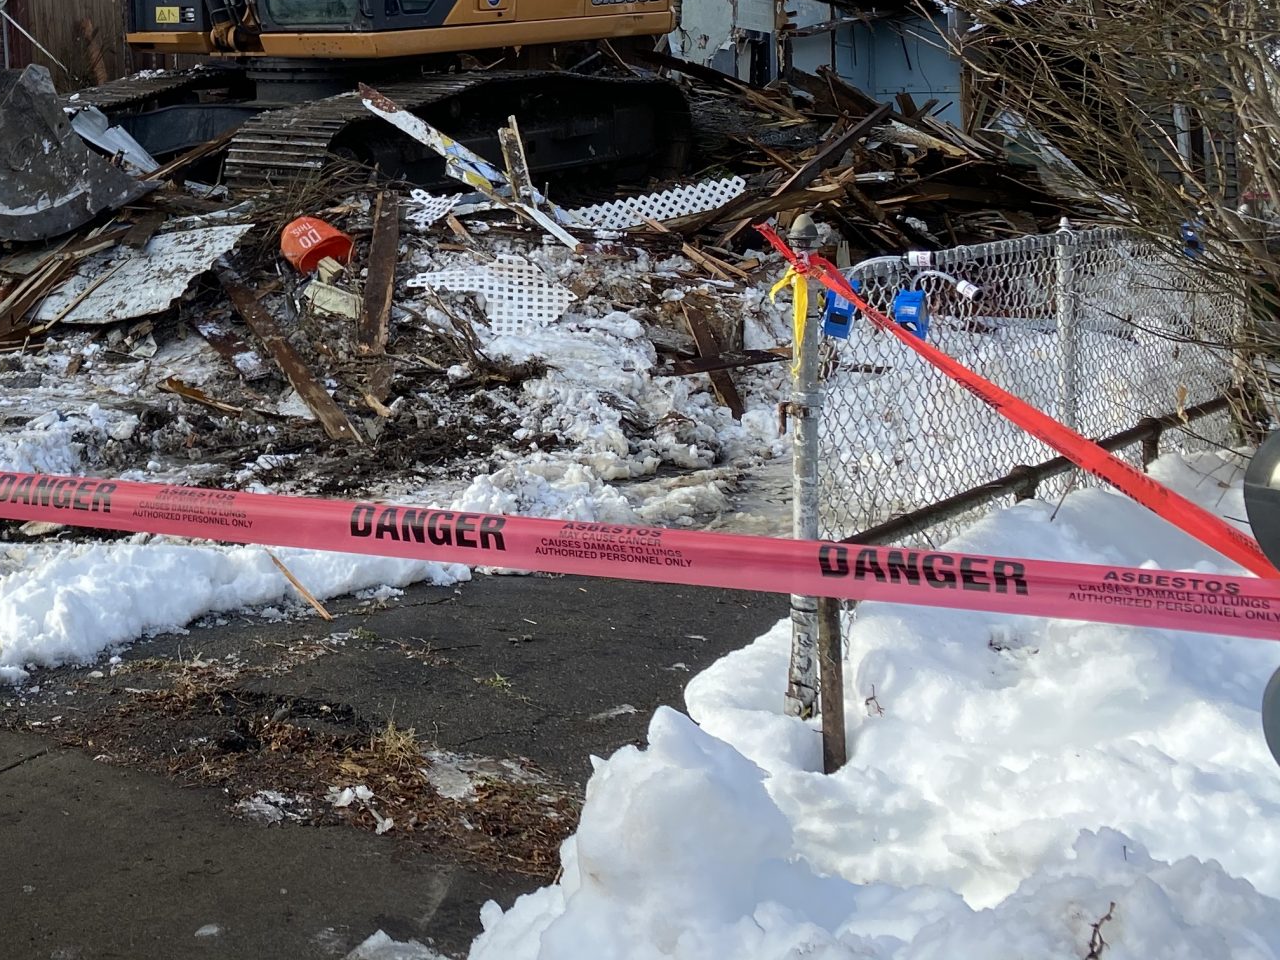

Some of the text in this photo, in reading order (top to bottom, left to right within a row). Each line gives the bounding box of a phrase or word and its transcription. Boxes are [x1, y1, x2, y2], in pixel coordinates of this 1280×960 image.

[299, 228, 321, 249] DO
[160, 488, 236, 500] ASBESTOS
[133, 510, 253, 529] AUTHORIZED PERSONNEL ONLY
[139, 501, 247, 519] CAUSES DAMAGE TO LUNGS
[350, 504, 507, 551] DANGER
[562, 522, 663, 538] ASBESTOS
[541, 537, 682, 558] CAUSES DAMAGE TO LUNGS
[559, 530, 662, 547] MAY CAUSE CANCER
[535, 546, 692, 568] AUTHORIZED PERSONNEL ONLY
[818, 544, 1029, 596] DANGER
[1103, 570, 1241, 596] ASBESTOS
[1068, 591, 1280, 622] AUTHORIZED PERSONNEL ONLY
[1135, 587, 1199, 603] DAMAGE
[1200, 592, 1218, 605] TO
[1221, 595, 1270, 610] LUNGS
